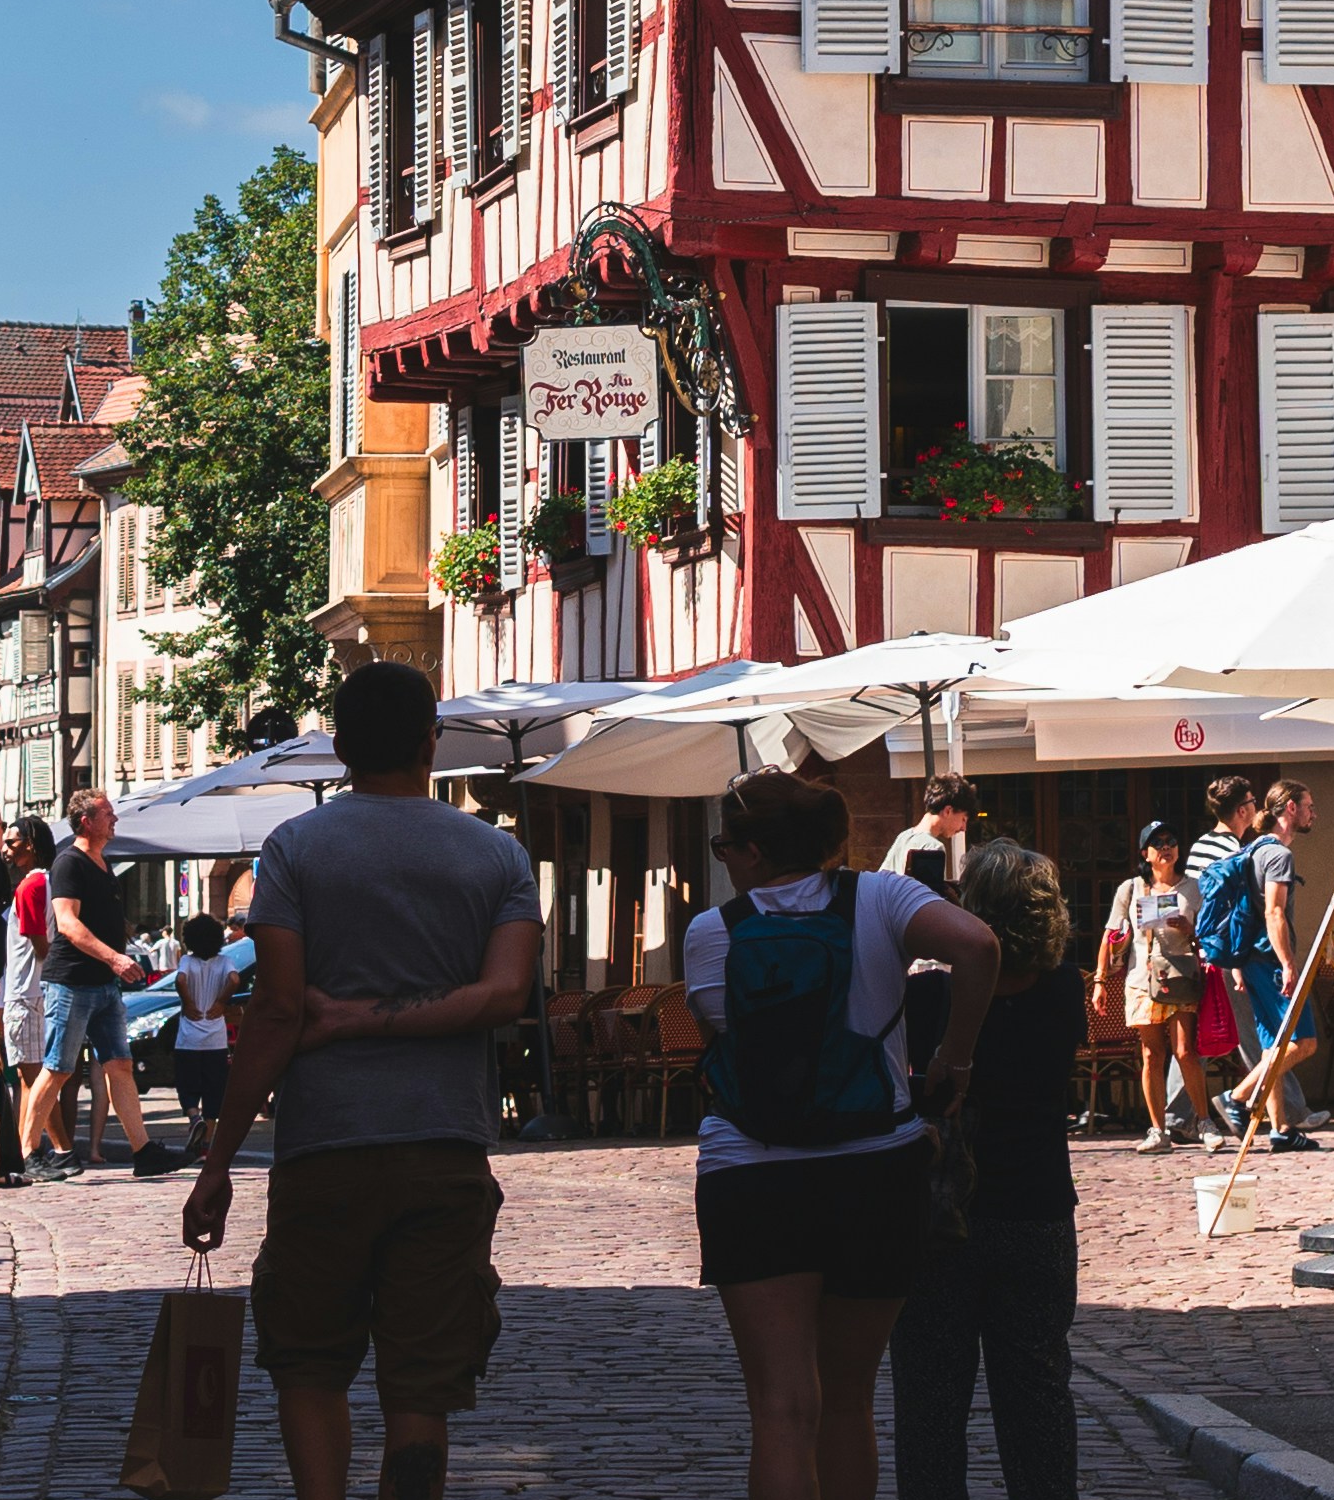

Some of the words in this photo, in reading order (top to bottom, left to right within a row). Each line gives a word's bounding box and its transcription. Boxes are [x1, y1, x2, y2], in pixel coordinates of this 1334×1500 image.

[552, 348, 626, 369] Restaurant
[608, 372, 633, 387] Au
[529, 381, 577, 424] Fer
[574, 377, 648, 418] Rouge
